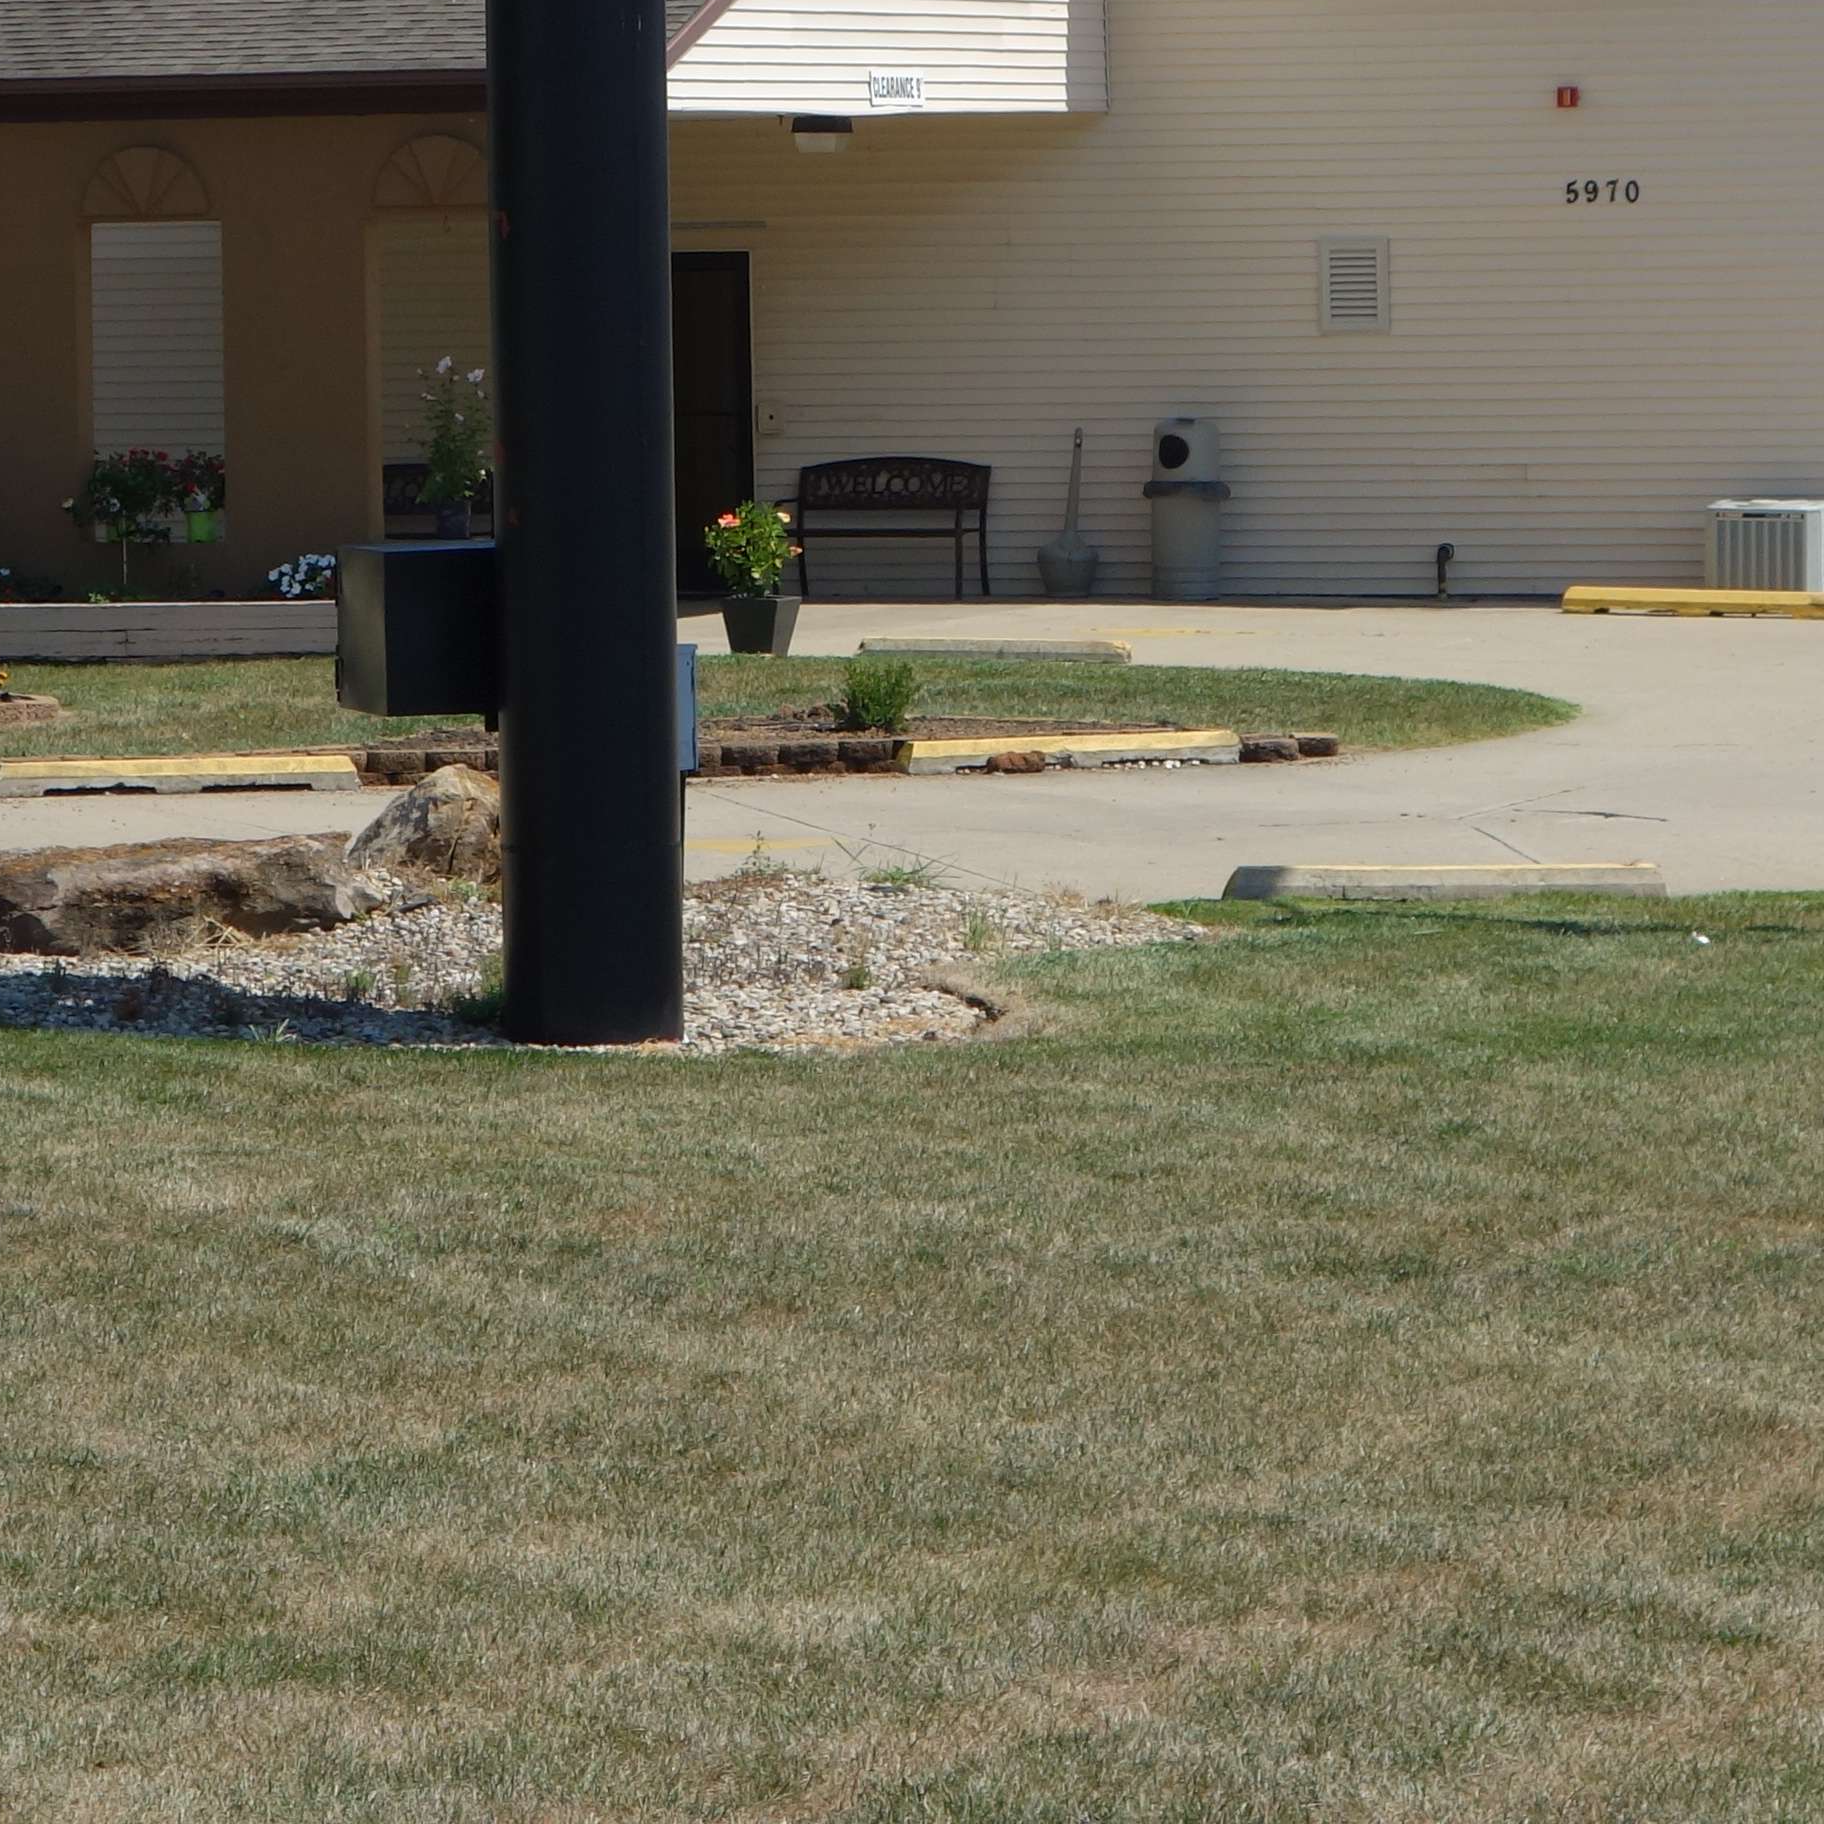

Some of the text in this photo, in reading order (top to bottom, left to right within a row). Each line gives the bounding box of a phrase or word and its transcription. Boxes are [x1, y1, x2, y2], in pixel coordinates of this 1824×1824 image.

[873, 76, 915, 99] CLEARANCE
[1565, 179, 1640, 204] 5970
[824, 473, 969, 496] WELCOME
